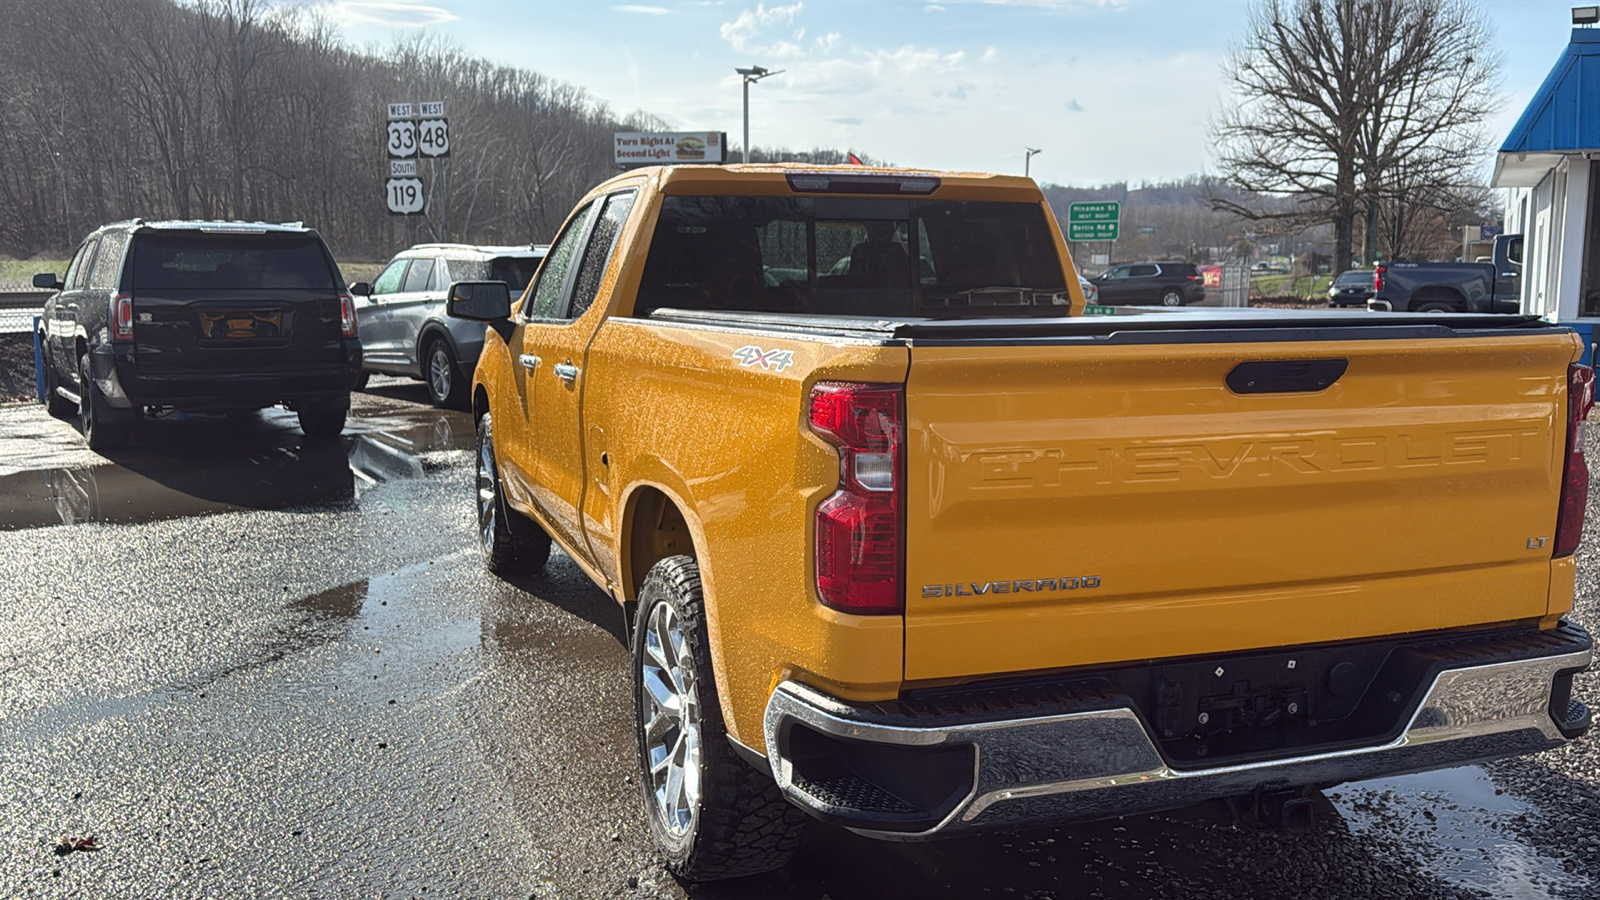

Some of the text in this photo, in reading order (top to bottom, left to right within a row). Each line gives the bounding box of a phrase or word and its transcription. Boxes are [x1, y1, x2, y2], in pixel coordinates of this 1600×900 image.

[389, 104, 411, 116] WEST
[421, 103, 443, 115] WEST
[391, 128, 414, 149] 33
[422, 127, 446, 149] 48
[616, 136, 675, 148] Turn Right At
[616, 148, 670, 159] Second Light
[392, 162, 415, 174] SOUTH
[392, 185, 417, 206] 119
[966, 427, 1539, 490] CHEVROLET
[1527, 536, 1550, 549] LT
[922, 575, 1101, 598] SILVERADO
